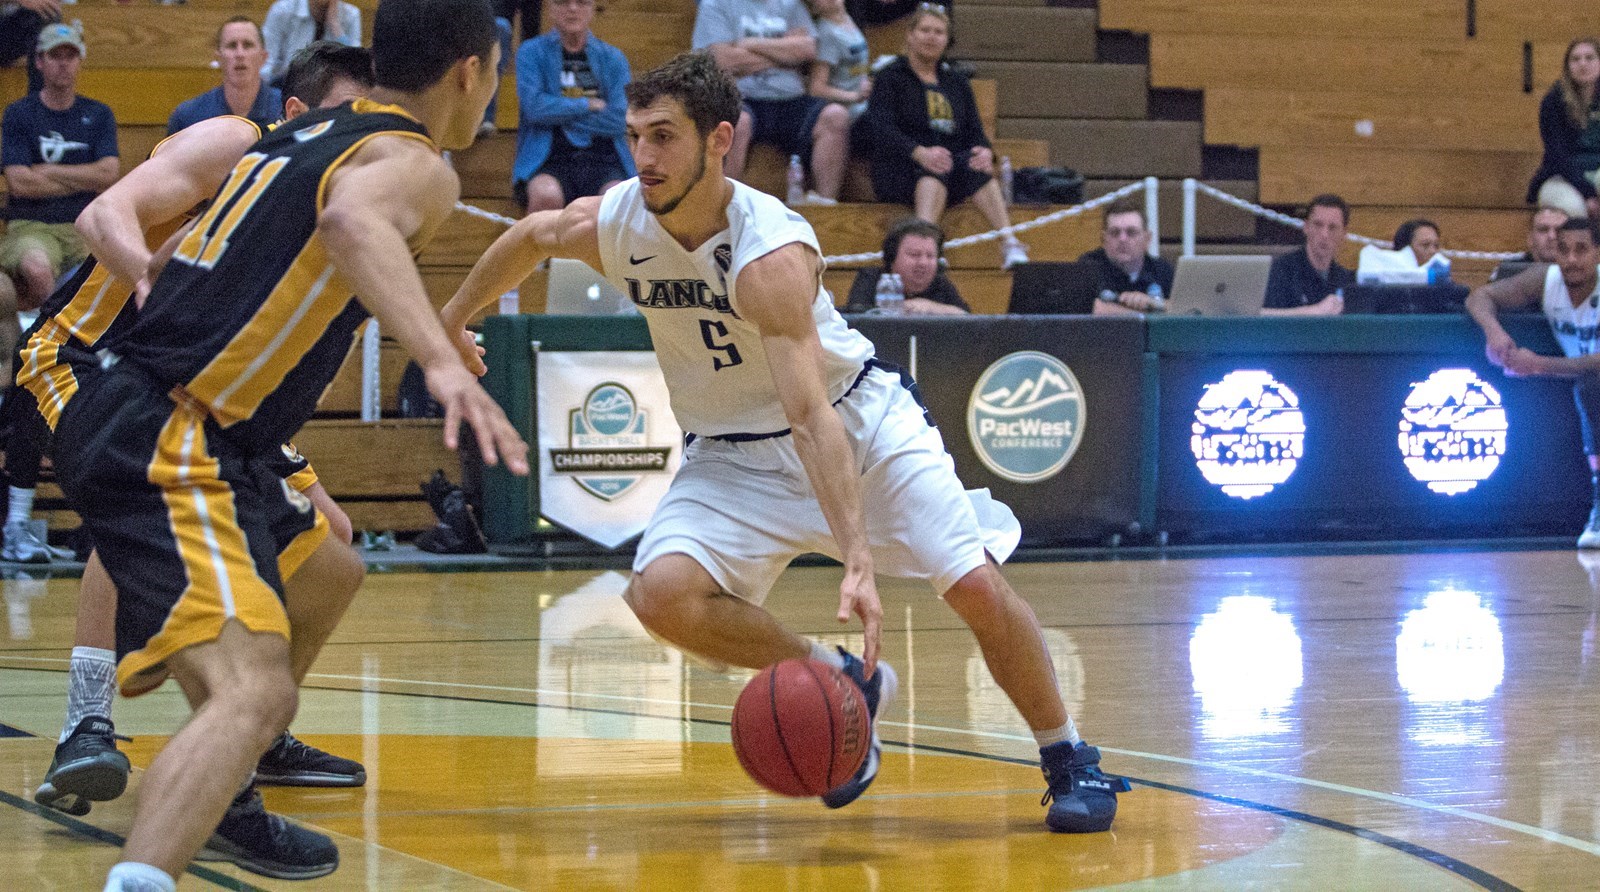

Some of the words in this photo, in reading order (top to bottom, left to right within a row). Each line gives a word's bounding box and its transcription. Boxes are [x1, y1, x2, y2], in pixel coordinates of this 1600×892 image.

[172, 151, 292, 270] 11
[698, 318, 743, 372] 5
[979, 418, 1073, 438] PacWest
[991, 438, 1062, 449] CONFERENCE
[554, 452, 664, 466] CHAMPIONSHIPS
